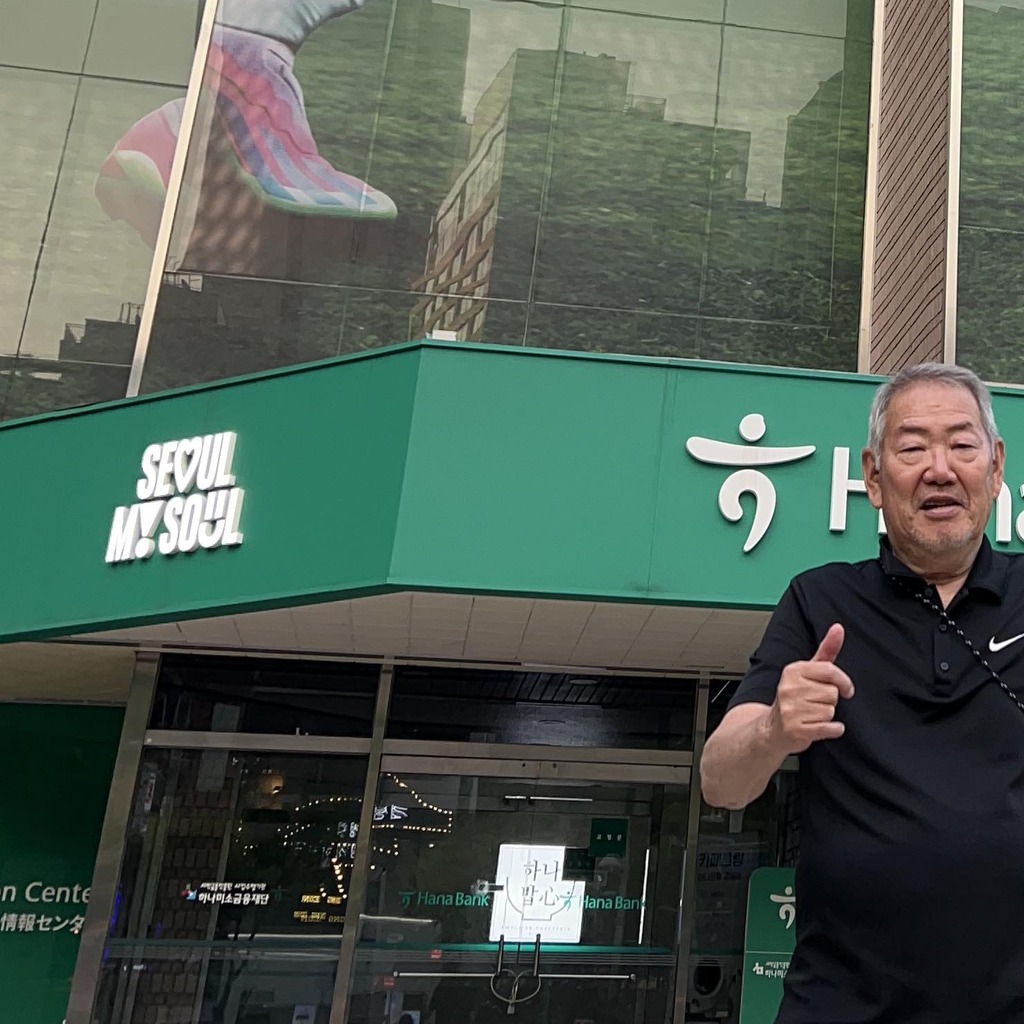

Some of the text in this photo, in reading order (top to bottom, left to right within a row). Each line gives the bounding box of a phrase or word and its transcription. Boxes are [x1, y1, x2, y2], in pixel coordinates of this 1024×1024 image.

[157, 487, 245, 556] SOUL
[523, 859, 561, 882] 하나
[24, 881, 92, 903] Cente
[417, 891, 490, 907] Hana Bank
[0, 912, 86, 934] 情報センタ
